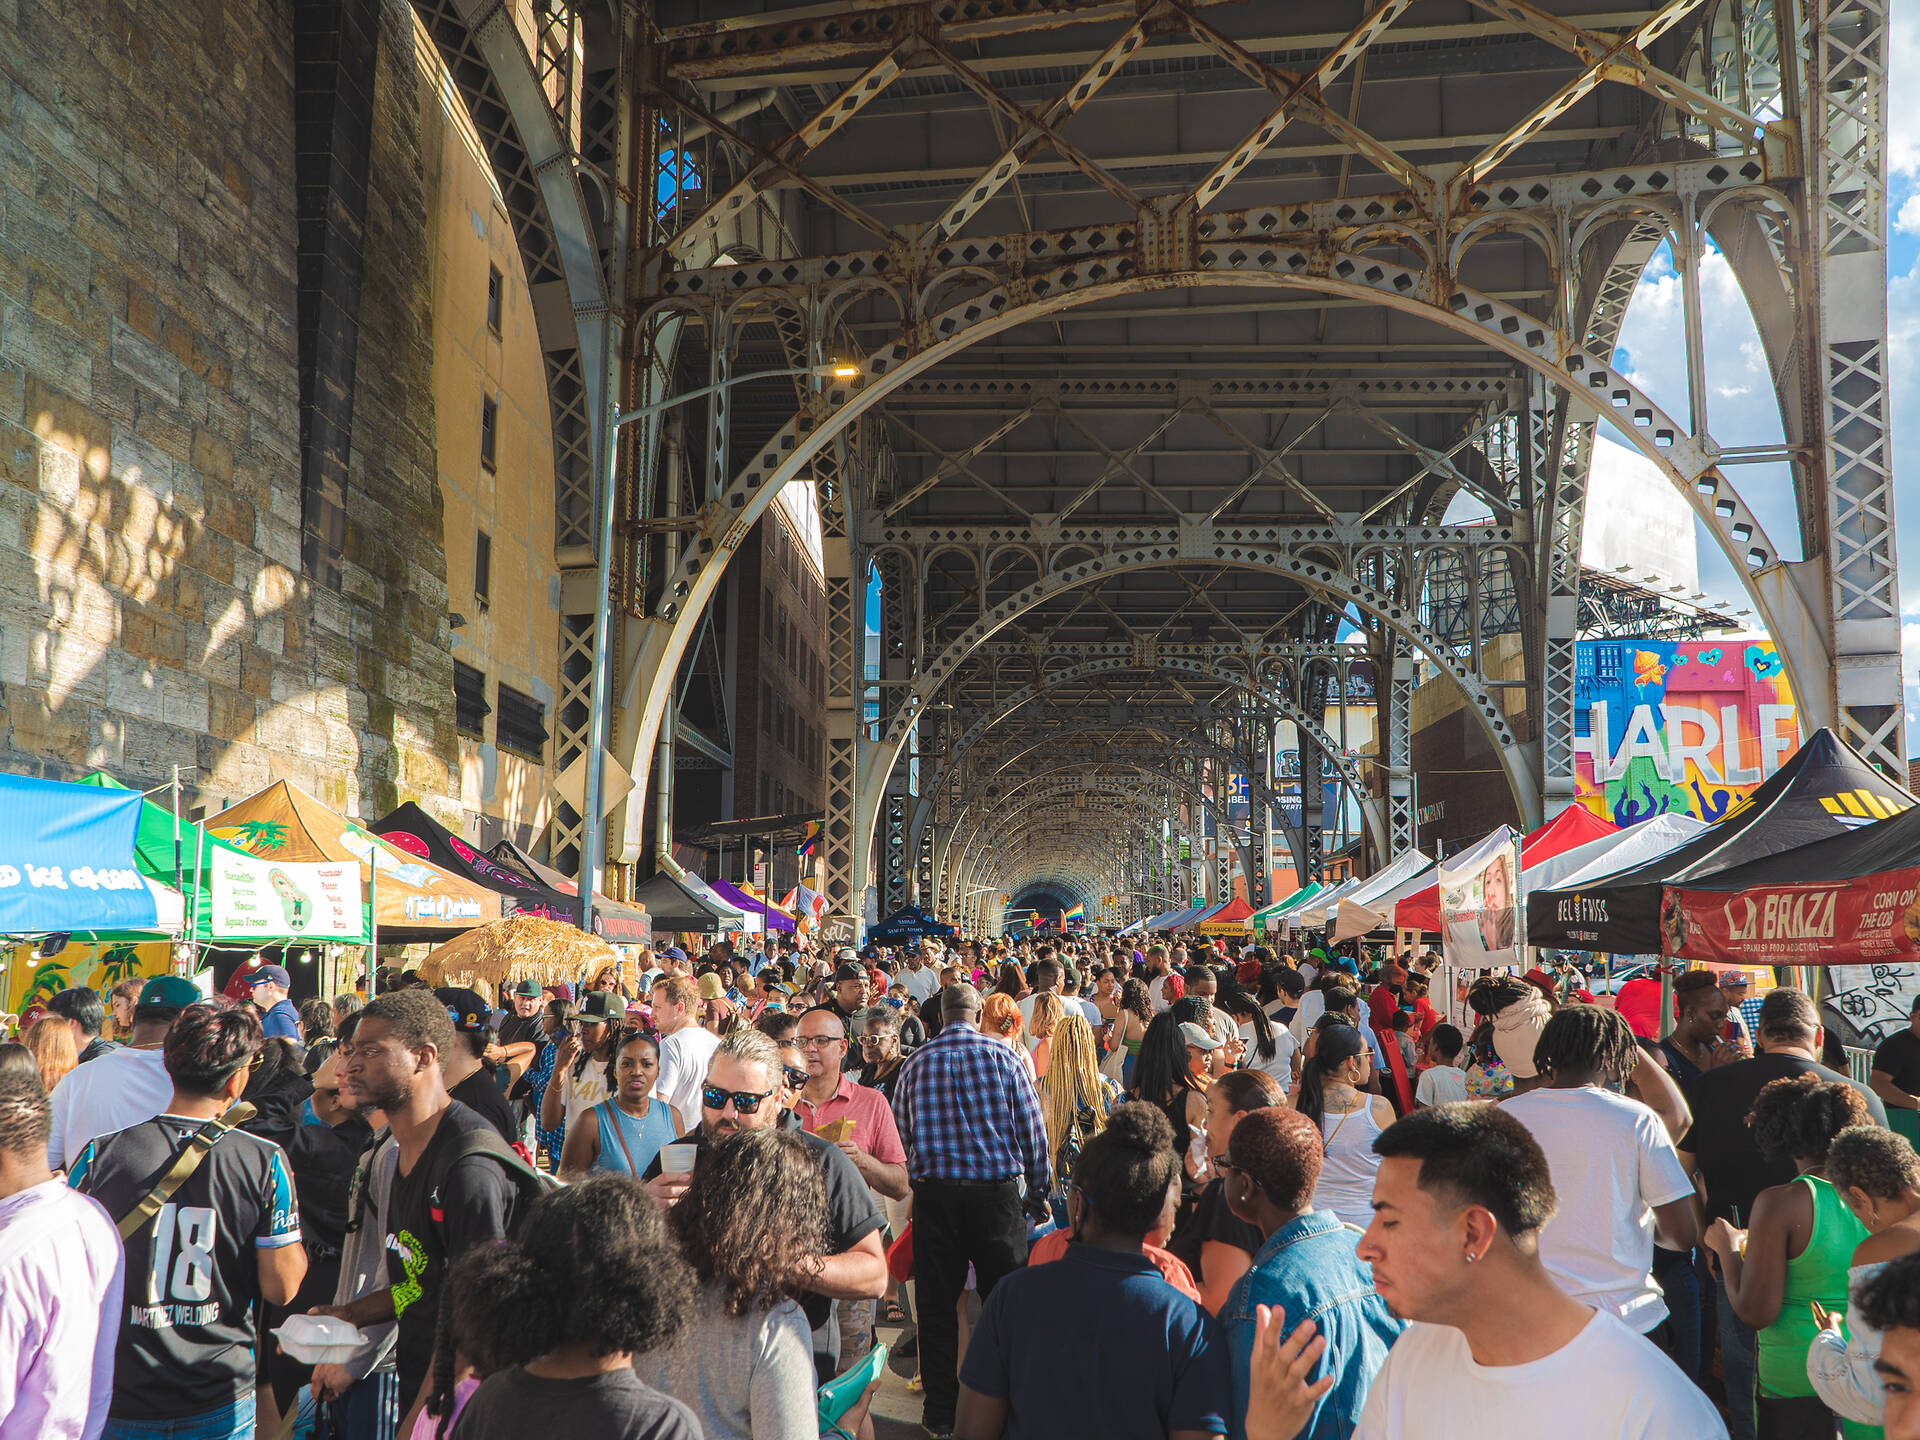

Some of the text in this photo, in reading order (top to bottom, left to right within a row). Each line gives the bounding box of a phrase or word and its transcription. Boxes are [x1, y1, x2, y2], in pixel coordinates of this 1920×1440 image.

[1899, 888, 1917, 907] ON
[1723, 890, 1838, 941] LA BRAZA
[1859, 913, 1878, 929] THE
[149, 1202, 217, 1305] 18
[130, 1300, 219, 1330] MARTINEZ WELDING
